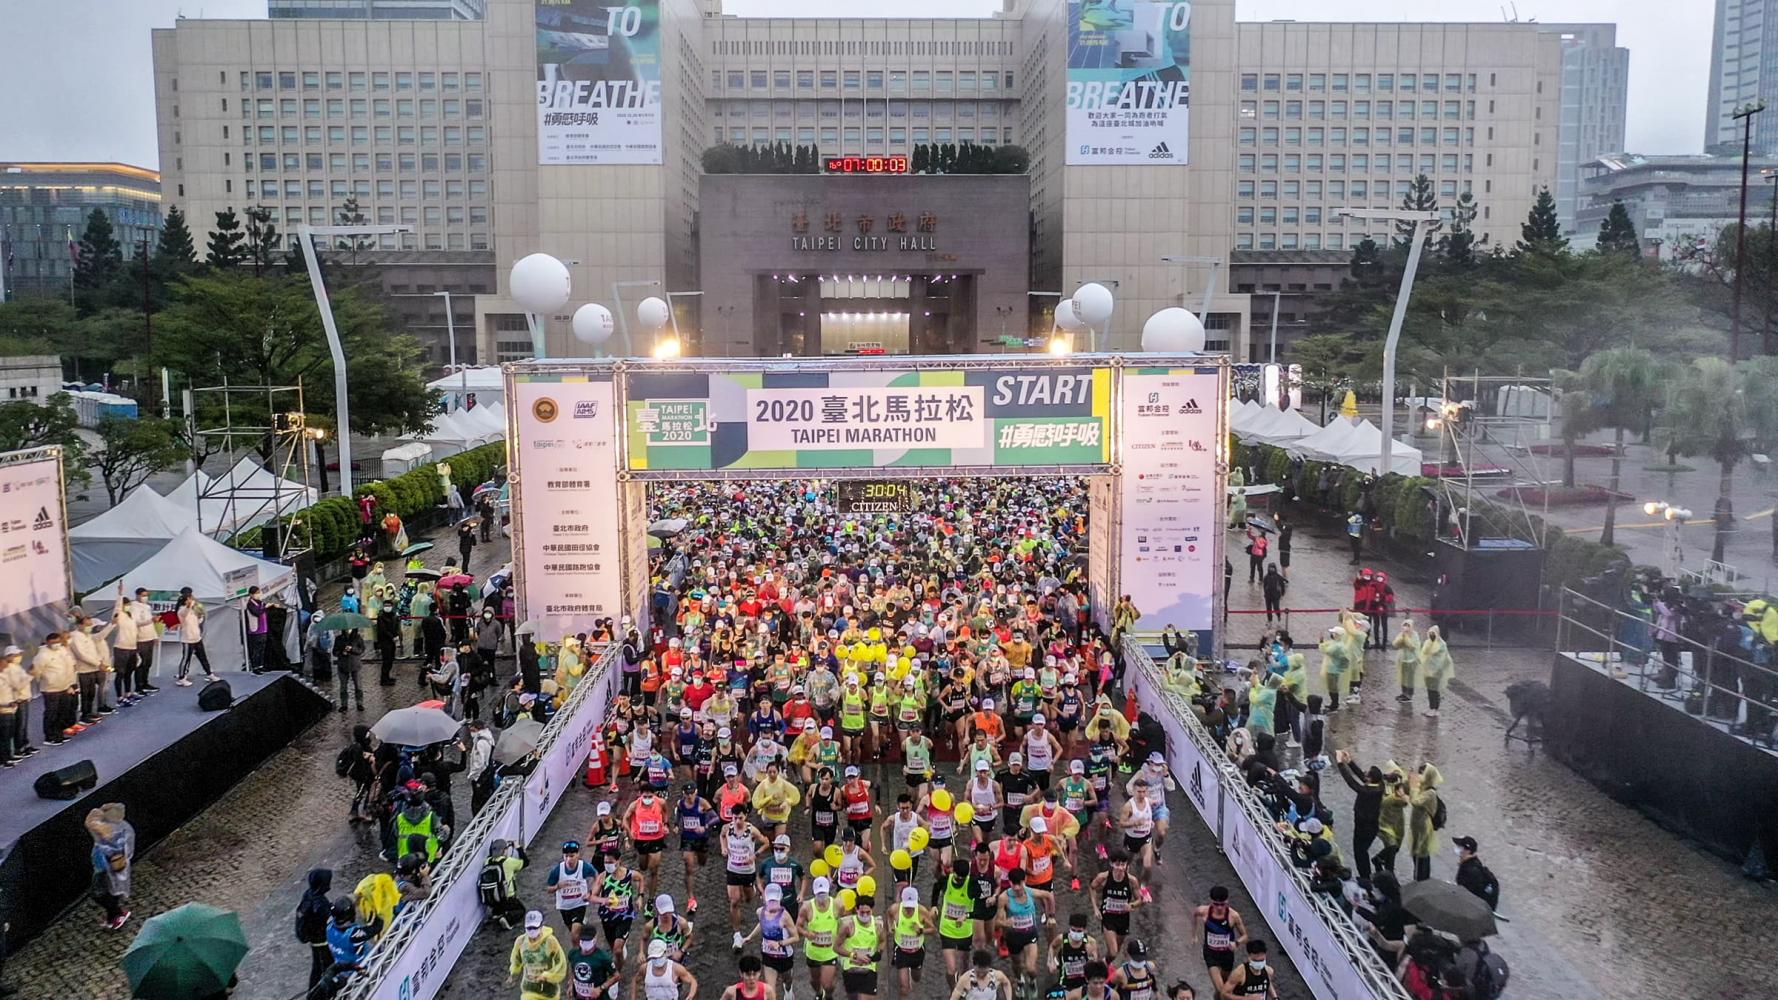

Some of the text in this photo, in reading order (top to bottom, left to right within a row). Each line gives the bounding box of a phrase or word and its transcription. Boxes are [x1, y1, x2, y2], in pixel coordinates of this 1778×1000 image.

[606, 6, 642, 36] TO
[1152, 2, 1191, 31] TO
[537, 80, 662, 109] BREATHE
[1066, 81, 1189, 109] BREATHE
[843, 159, 906, 171] 07:00:03
[792, 236, 937, 250] TAIPEI CITY HALL
[992, 375, 1094, 406] START
[661, 404, 692, 414] TAIPEI
[755, 394, 974, 424] 2020 臺北馬拉松
[661, 421, 693, 431] 馬拉松
[662, 431, 692, 440] 2020
[791, 427, 937, 444] TAIPEI MARATHON
[851, 502, 897, 512] CITIZEN
[553, 524, 589, 532] 臺北市政府
